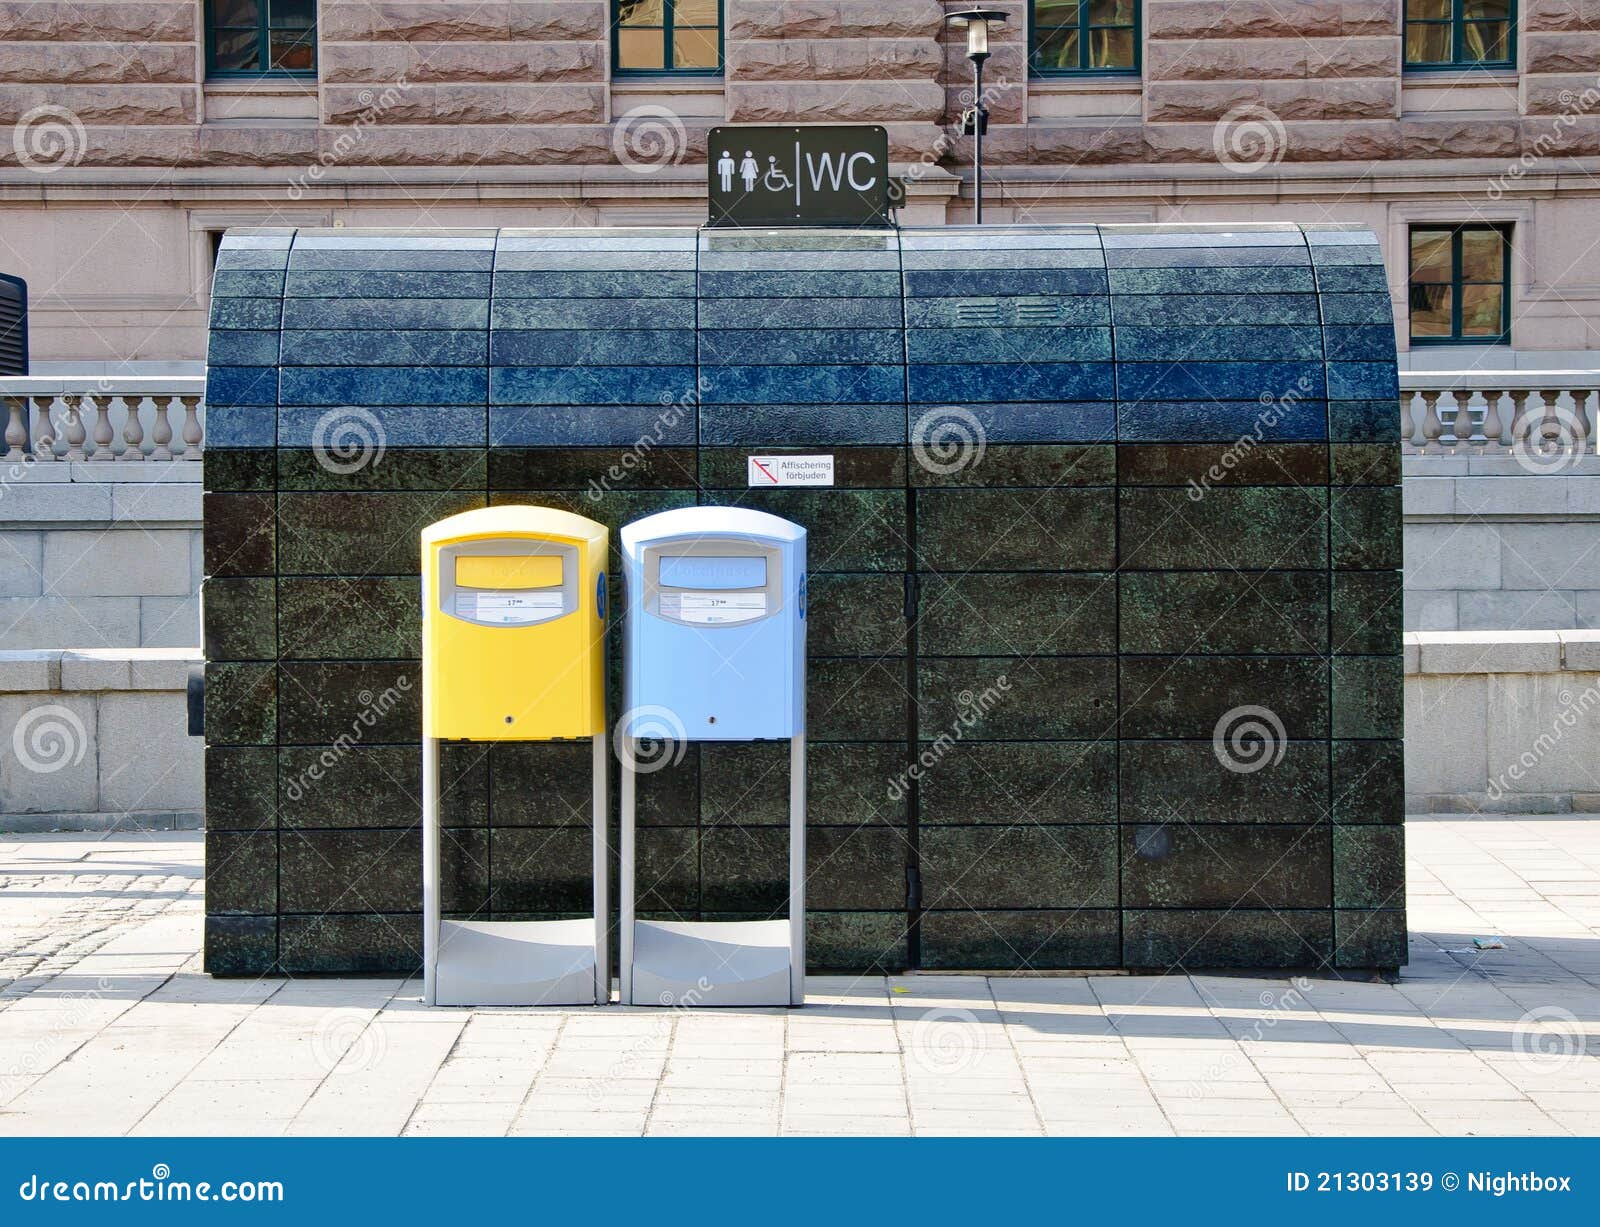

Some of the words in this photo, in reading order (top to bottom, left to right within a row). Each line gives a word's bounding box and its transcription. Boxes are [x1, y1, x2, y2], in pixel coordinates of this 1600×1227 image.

[805, 152, 876, 191] WC
[781, 461, 831, 470] Affischering
[786, 471, 827, 480] förbjuden
